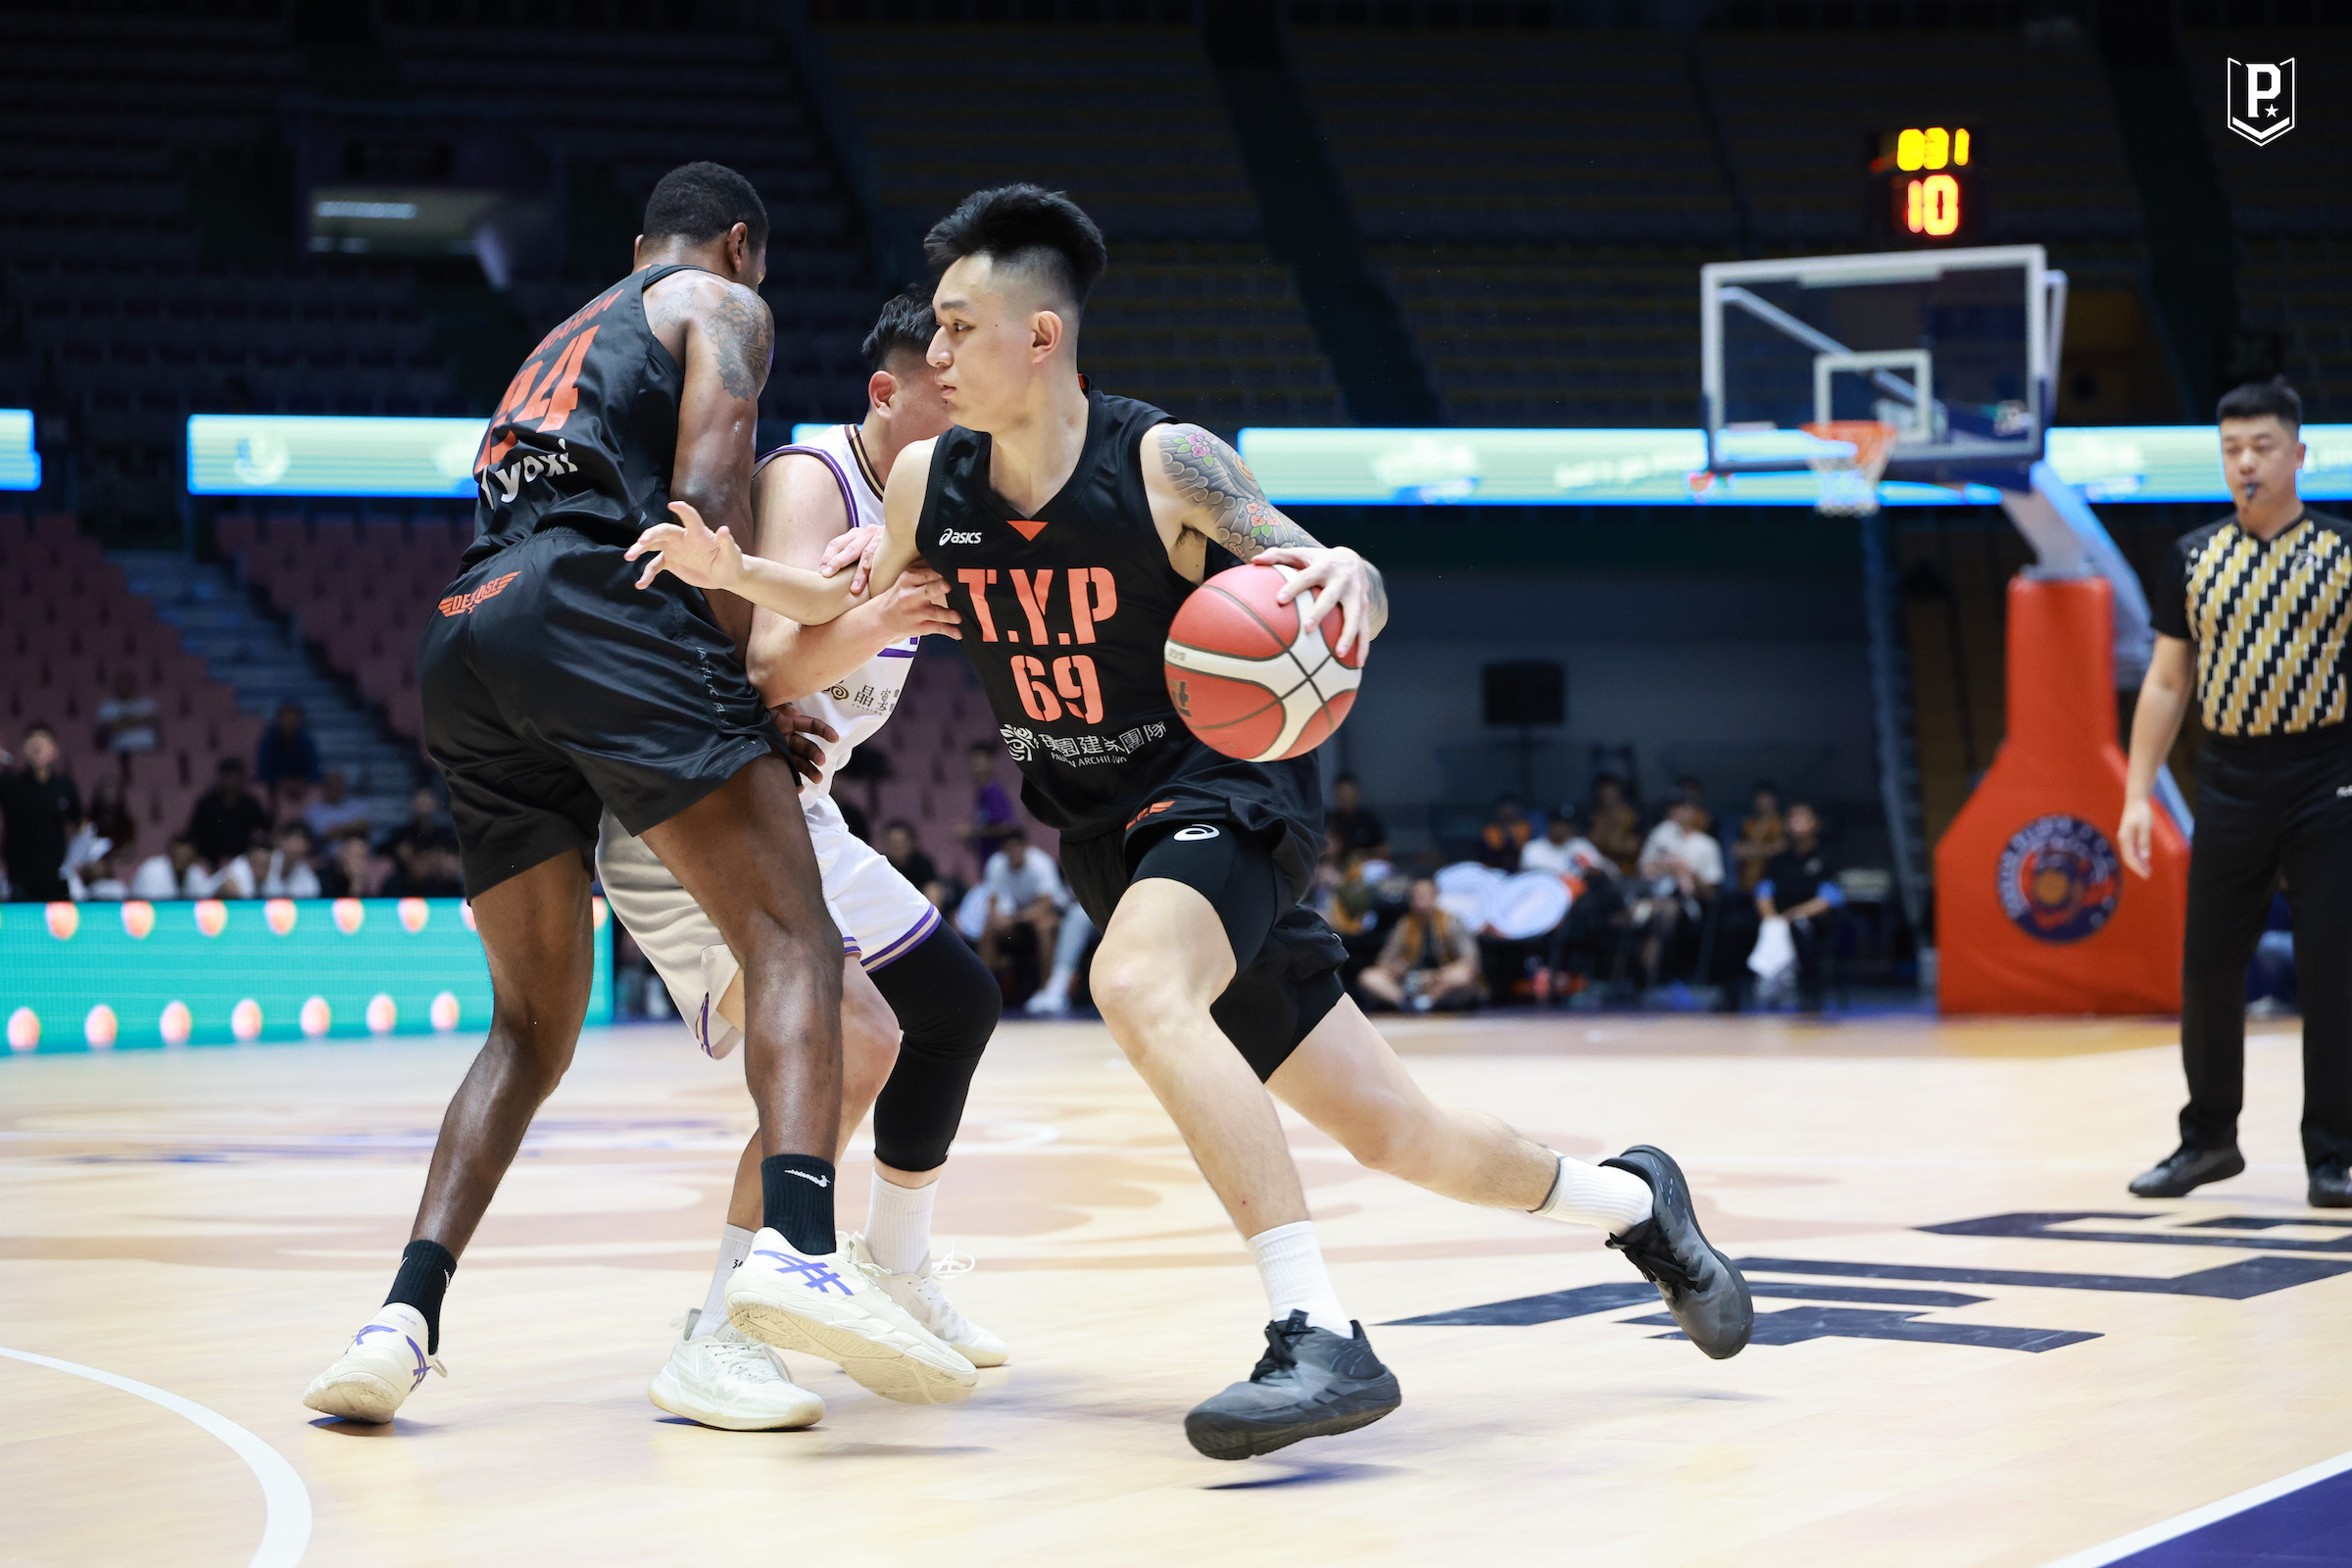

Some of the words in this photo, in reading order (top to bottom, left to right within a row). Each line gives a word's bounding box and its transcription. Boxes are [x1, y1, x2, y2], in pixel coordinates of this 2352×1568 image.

[1908, 174, 1958, 235] 10
[495, 438, 578, 504] yoxi
[951, 531, 983, 545] asics
[956, 566, 1118, 646] T.Y.P
[1009, 654, 1104, 725] 69
